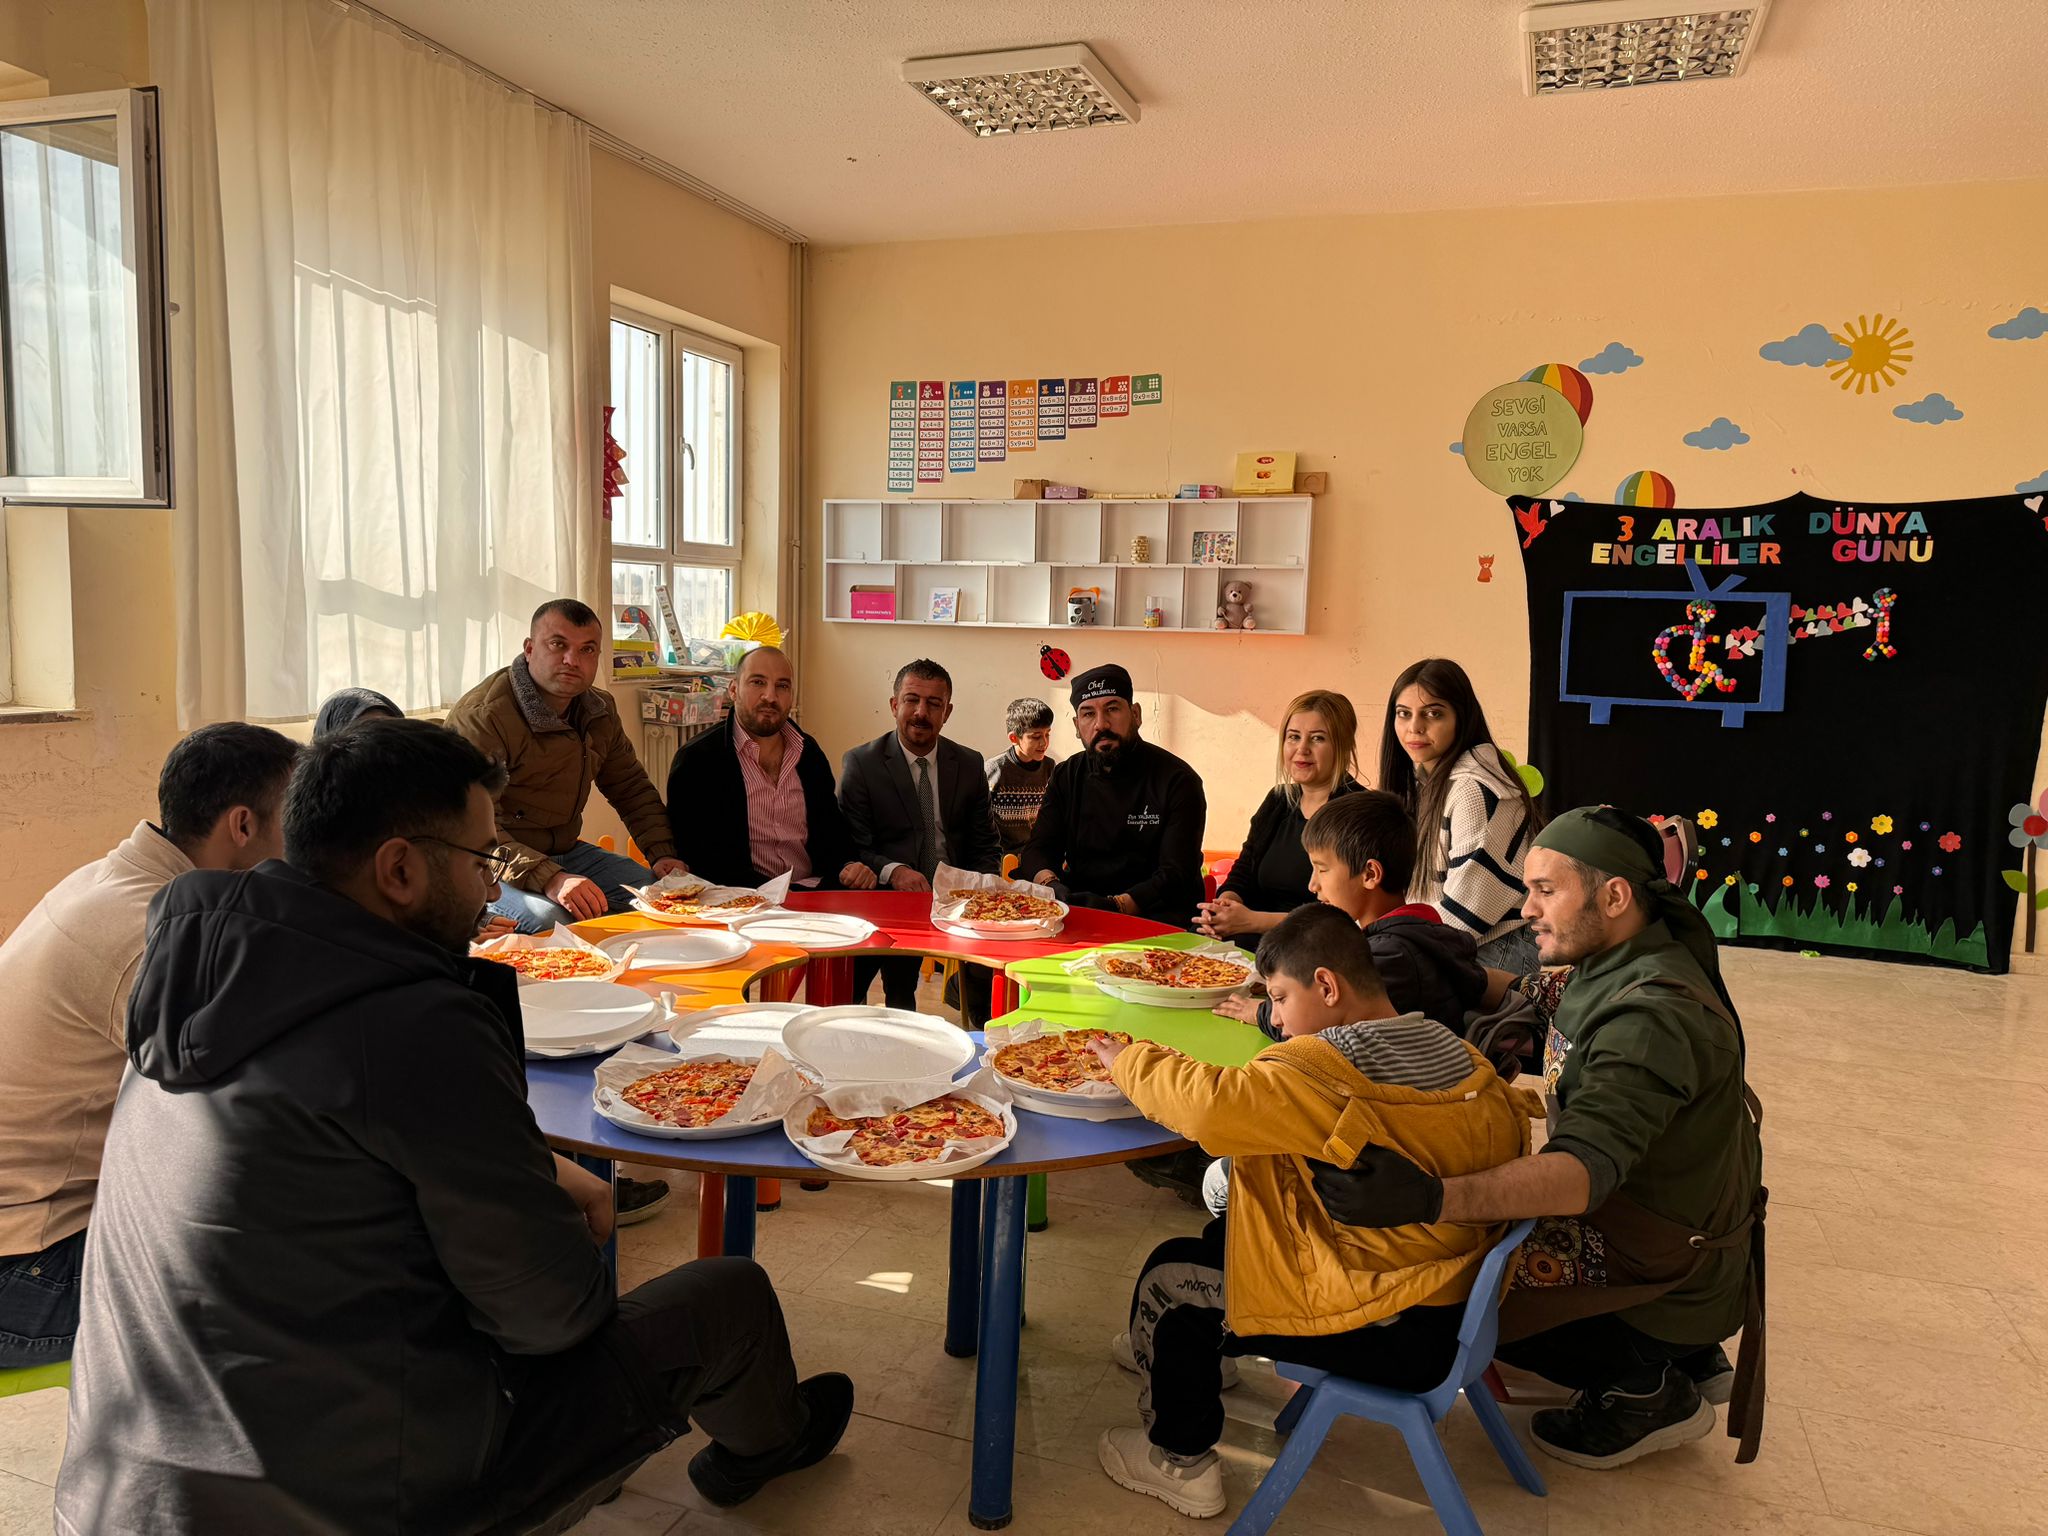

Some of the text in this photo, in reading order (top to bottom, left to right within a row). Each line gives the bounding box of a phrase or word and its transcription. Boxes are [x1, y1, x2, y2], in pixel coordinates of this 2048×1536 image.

[1134, 392, 1160, 400] 9x9=81
[1491, 395, 1546, 417] SEVGİ
[1497, 420, 1548, 438] VARSA
[1485, 441, 1557, 461] ENGEL
[1508, 466, 1544, 483] YOK
[1616, 507, 1928, 542] 3 ARALIK DÜNYA
[1831, 535, 1934, 563] GÜNÜ
[1088, 679, 1105, 690] Chef
